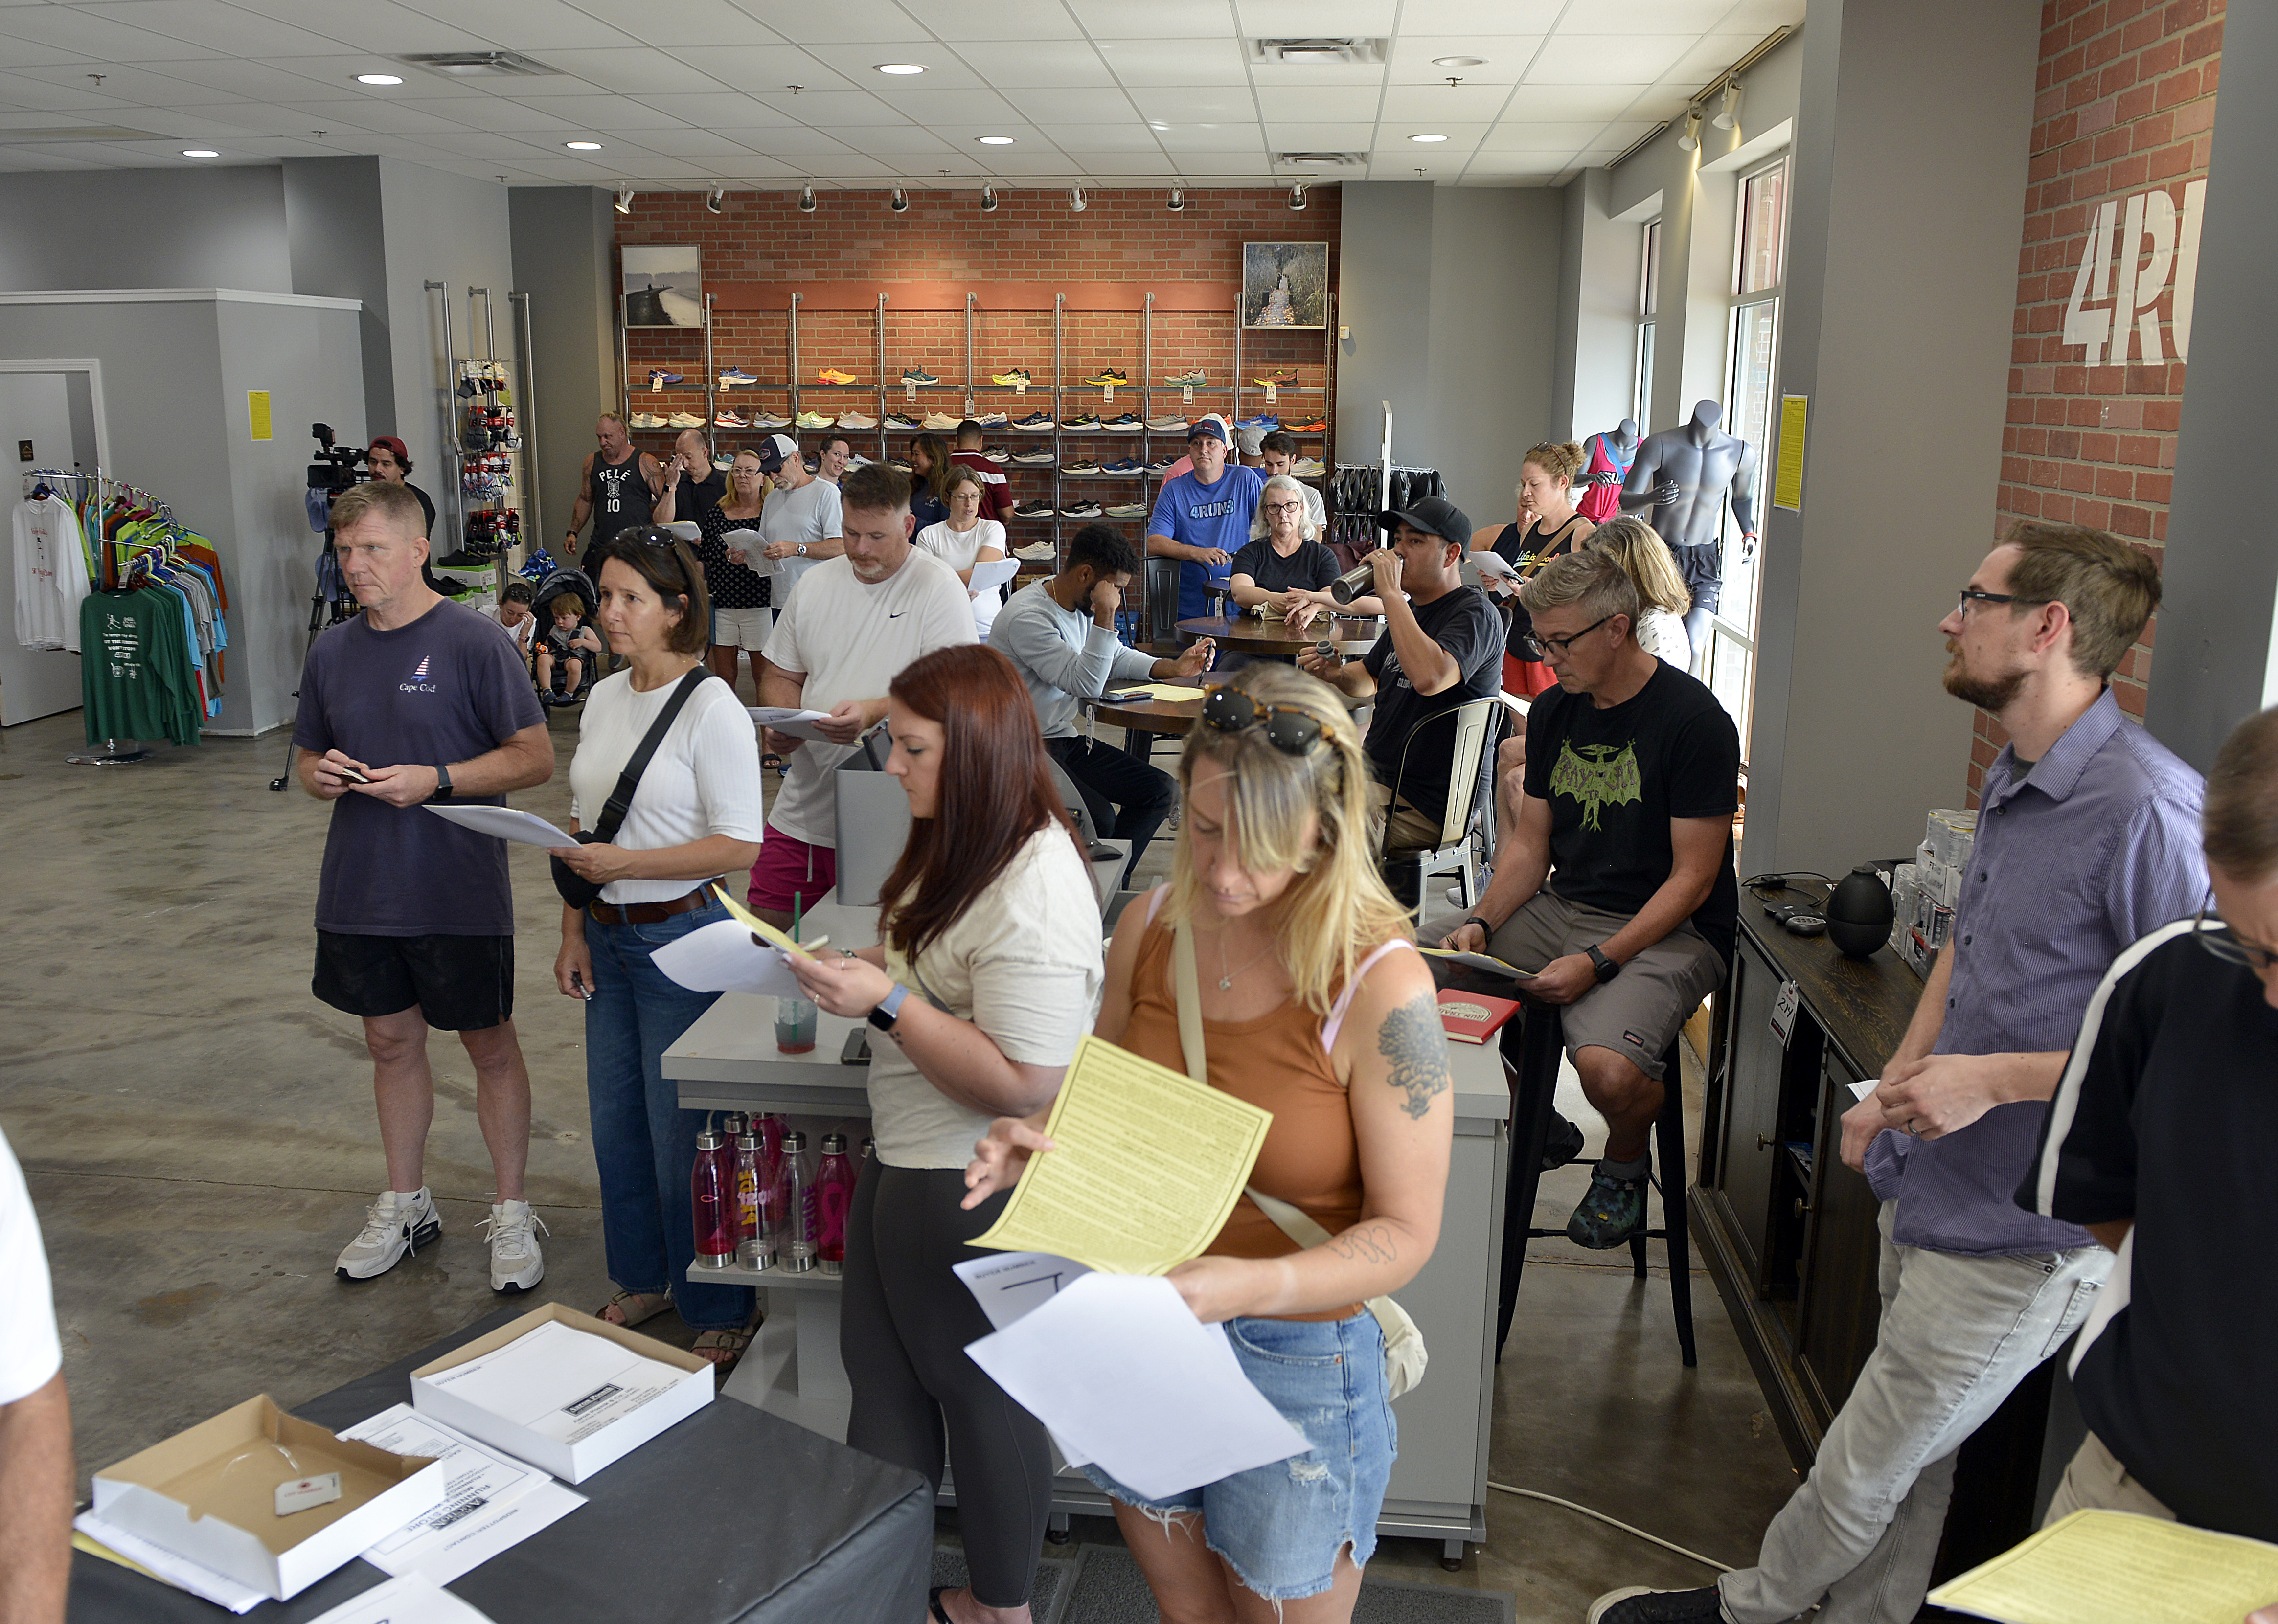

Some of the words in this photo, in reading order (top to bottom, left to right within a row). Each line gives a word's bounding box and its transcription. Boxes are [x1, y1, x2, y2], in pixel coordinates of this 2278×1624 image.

[598, 469, 631, 482] PELÉ
[607, 499, 620, 512] 10
[1189, 498, 1234, 519] 4RUN3
[1516, 550, 1530, 562] Life
[399, 683, 417, 693] Cape
[419, 683, 435, 693] Cod
[1777, 997, 1794, 1018] 214
[1786, 994, 1795, 1005] NUMBER
[801, 1182, 817, 1243] PRIDE
[435, 1376, 456, 1386] BUYER
[456, 1366, 482, 1378] NUMBER
[569, 1398, 592, 1413] Aaron
[590, 1386, 615, 1400] Posnik
[573, 1412, 590, 1423] Aaron
[591, 1402, 609, 1415] Posnik
[450, 1474, 481, 1494] RUNNING
[450, 1485, 475, 1500] MENS
[441, 1483, 492, 1513] RUNNING
[403, 1511, 442, 1533] STORE
[430, 1498, 483, 1529] AUCTION
[477, 1509, 519, 1534] BIDSPOTTER
[444, 1532, 476, 1551] CONTACT
